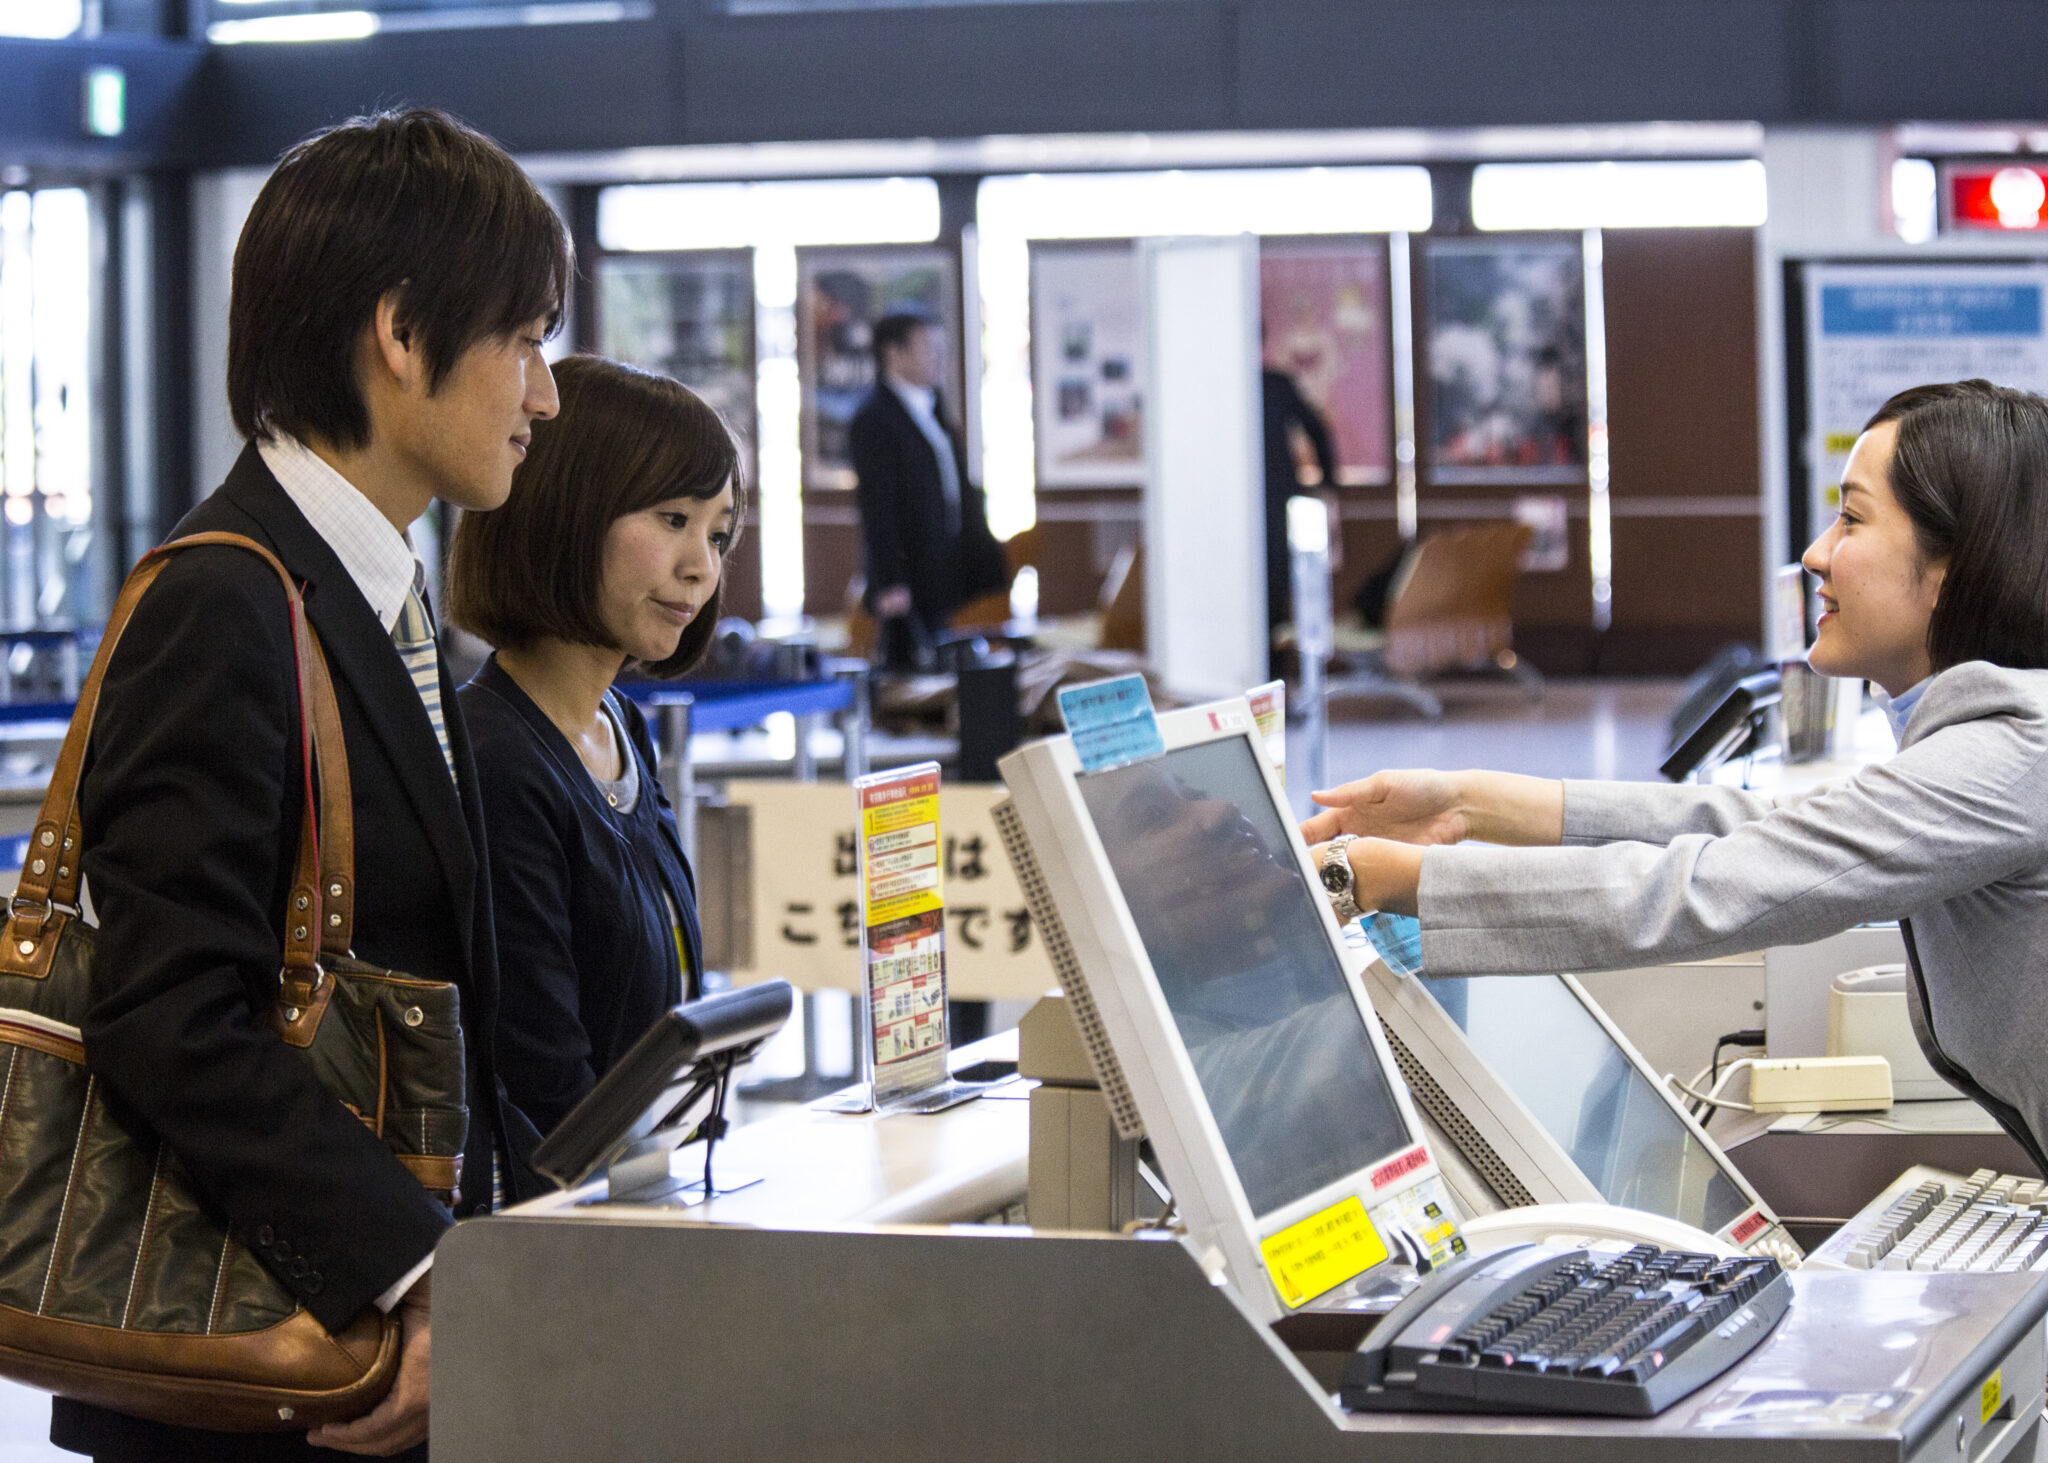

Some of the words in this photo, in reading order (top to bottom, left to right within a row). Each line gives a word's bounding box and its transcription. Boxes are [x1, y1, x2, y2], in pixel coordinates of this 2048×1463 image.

[834, 831, 987, 879] 出は
[782, 901, 1031, 951] こちです
